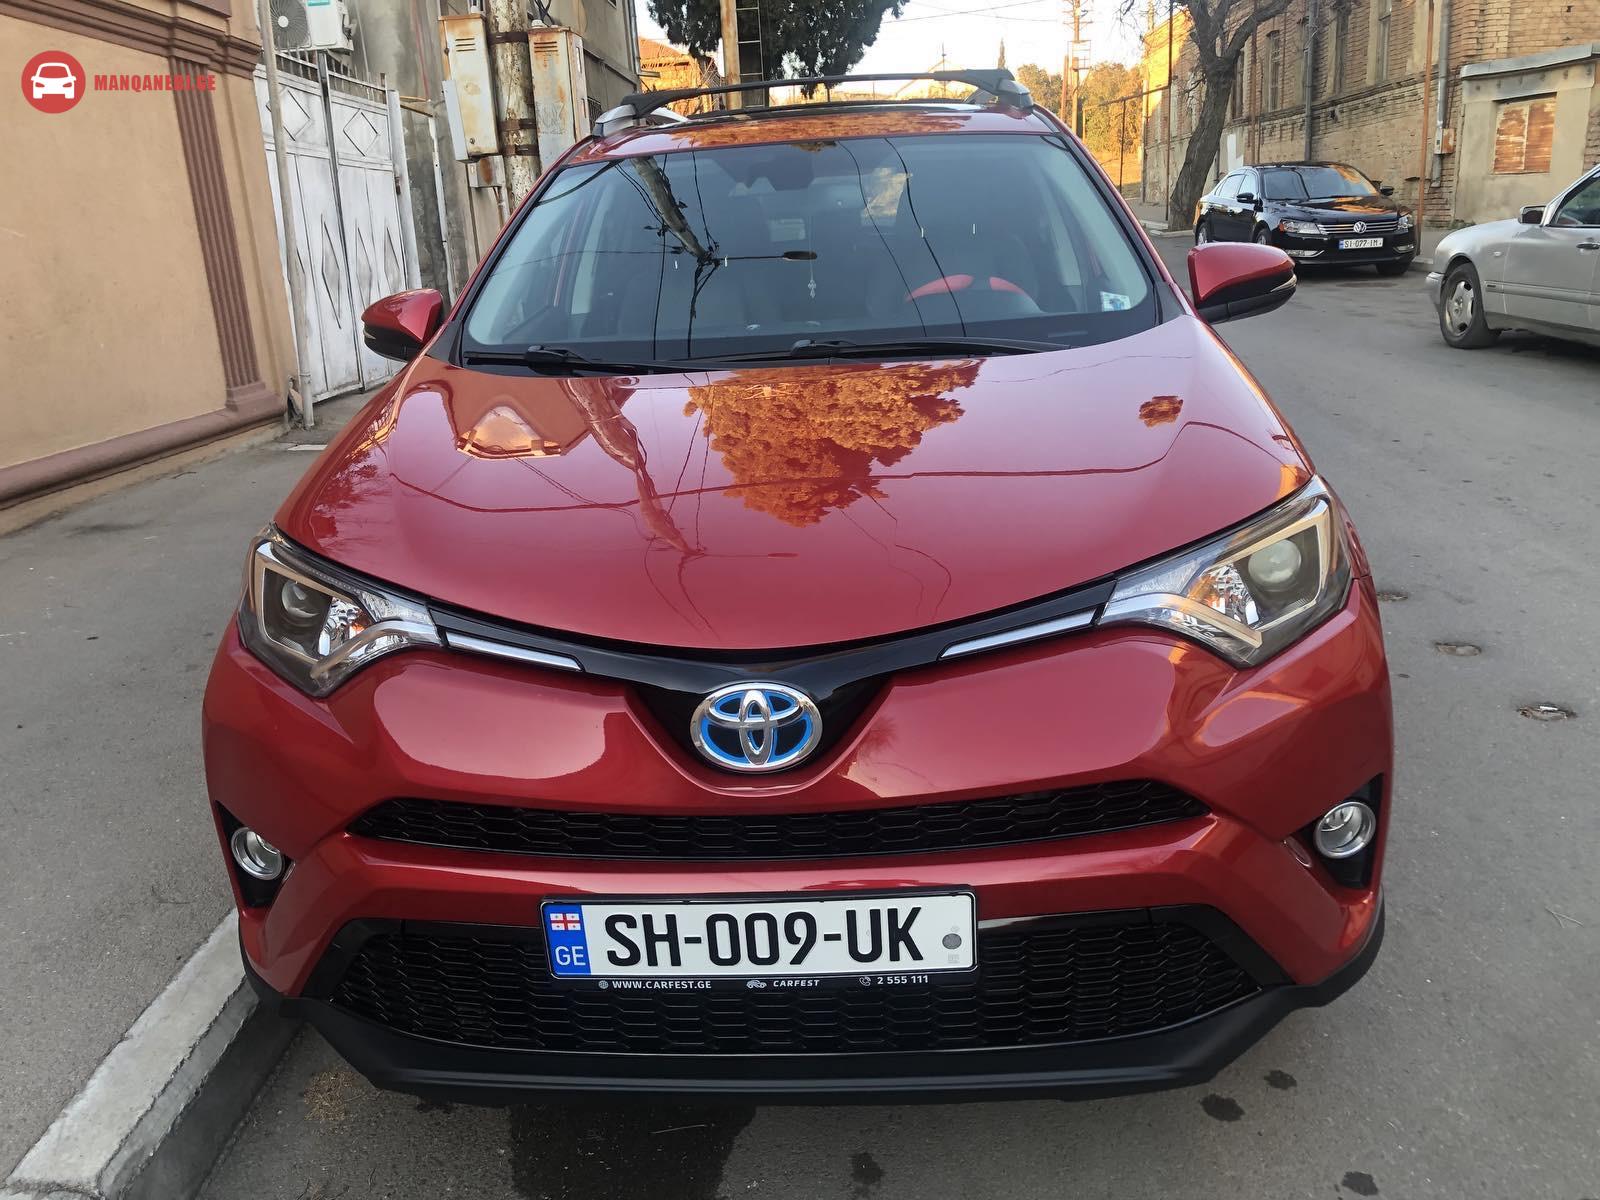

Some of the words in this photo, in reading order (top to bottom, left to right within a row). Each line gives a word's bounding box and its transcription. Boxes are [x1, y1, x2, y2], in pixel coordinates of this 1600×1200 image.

[604, 906, 923, 967] SH-009-UK
[554, 945, 587, 966] GE
[612, 980, 712, 989] WWW.CARFEST.GE
[773, 979, 820, 987] CARFEST
[877, 976, 884, 985] 2
[887, 976, 907, 985] 555
[910, 975, 929, 984] 111
